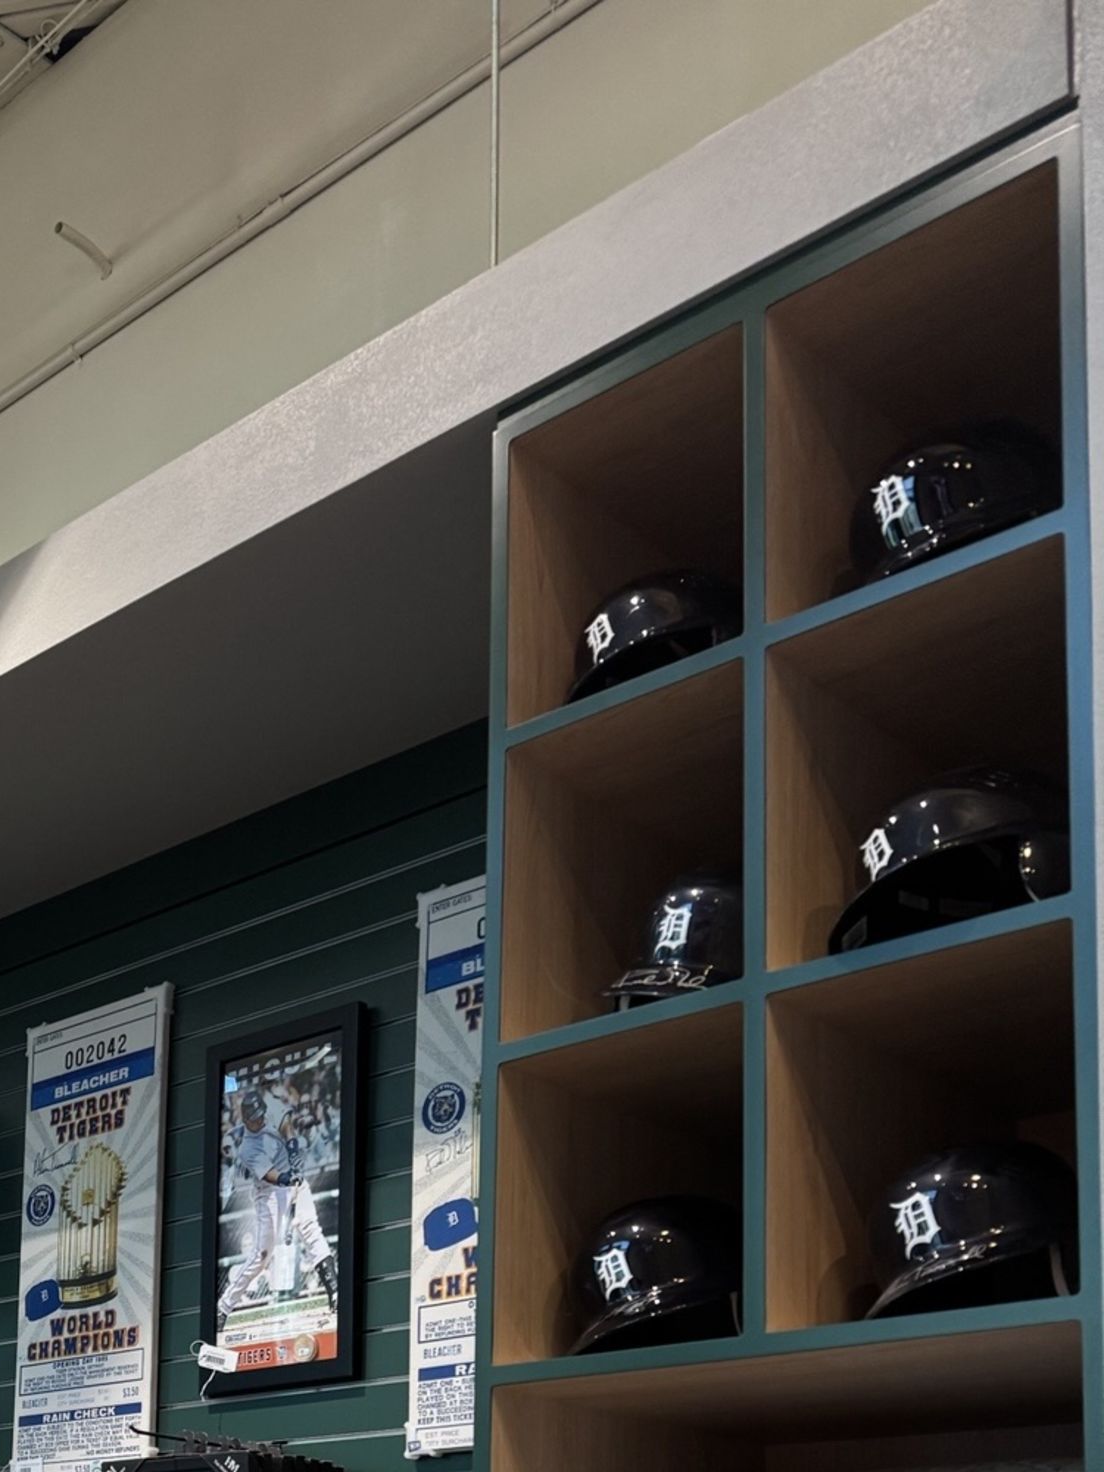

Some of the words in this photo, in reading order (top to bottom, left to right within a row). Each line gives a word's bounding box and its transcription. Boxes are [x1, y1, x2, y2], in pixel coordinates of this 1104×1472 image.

[585, 613, 615, 661] D
[859, 827, 893, 881] D
[654, 902, 692, 952] D
[65, 1034, 127, 1070] 002042
[54, 1066, 129, 1099] BLEACHER
[50, 1086, 132, 1126] DETROIT
[56, 1108, 126, 1145] TIGERS
[890, 1191, 942, 1260] D
[593, 1247, 634, 1300] D
[50, 1309, 115, 1338] WORLD
[27, 1325, 140, 1361] CHAMPIONS
[423, 1344, 462, 1359] BLEACHER
[42, 1411, 70, 1423] RAIN
[74, 1406, 116, 1420] CHECK
